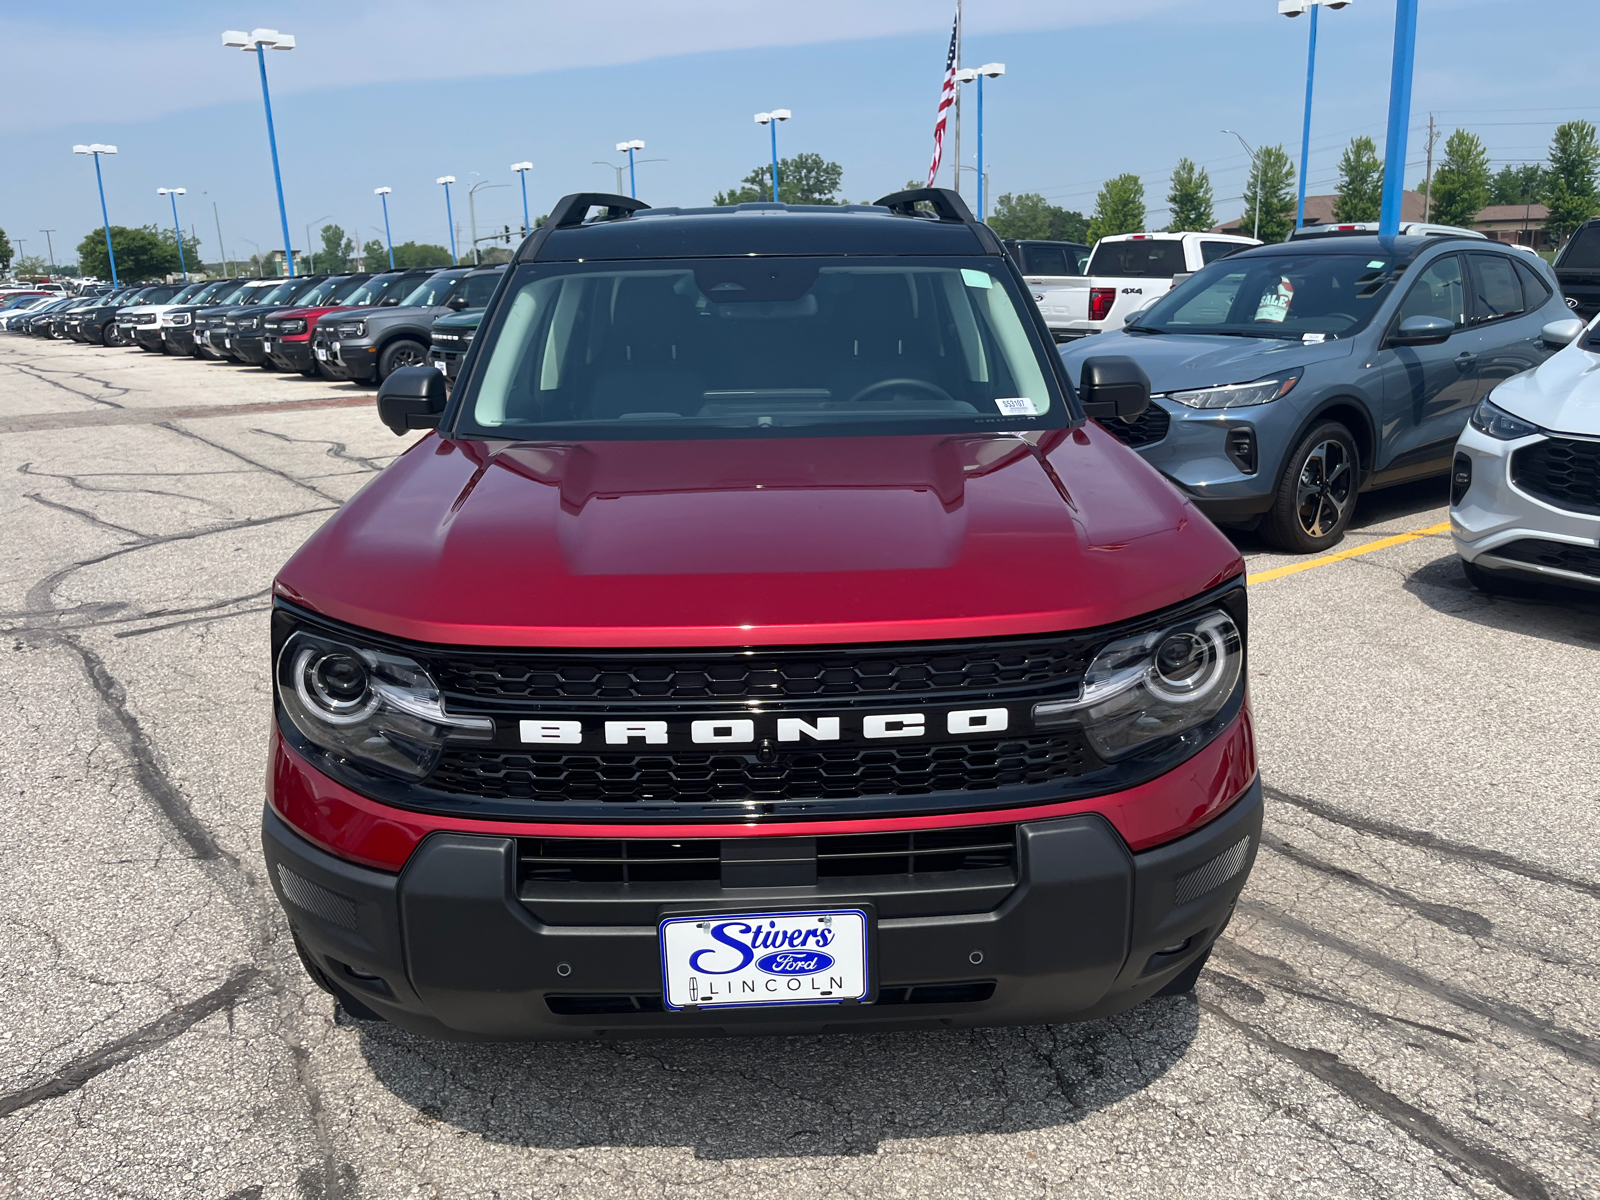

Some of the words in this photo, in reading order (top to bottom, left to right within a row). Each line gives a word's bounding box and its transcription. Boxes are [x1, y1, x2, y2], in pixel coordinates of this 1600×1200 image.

[1259, 294, 1289, 308] SALE
[519, 707, 1009, 745] BRONCO
[688, 920, 835, 975] Stivers
[772, 954, 818, 971] Ford
[710, 977, 843, 995] LINCOLN
